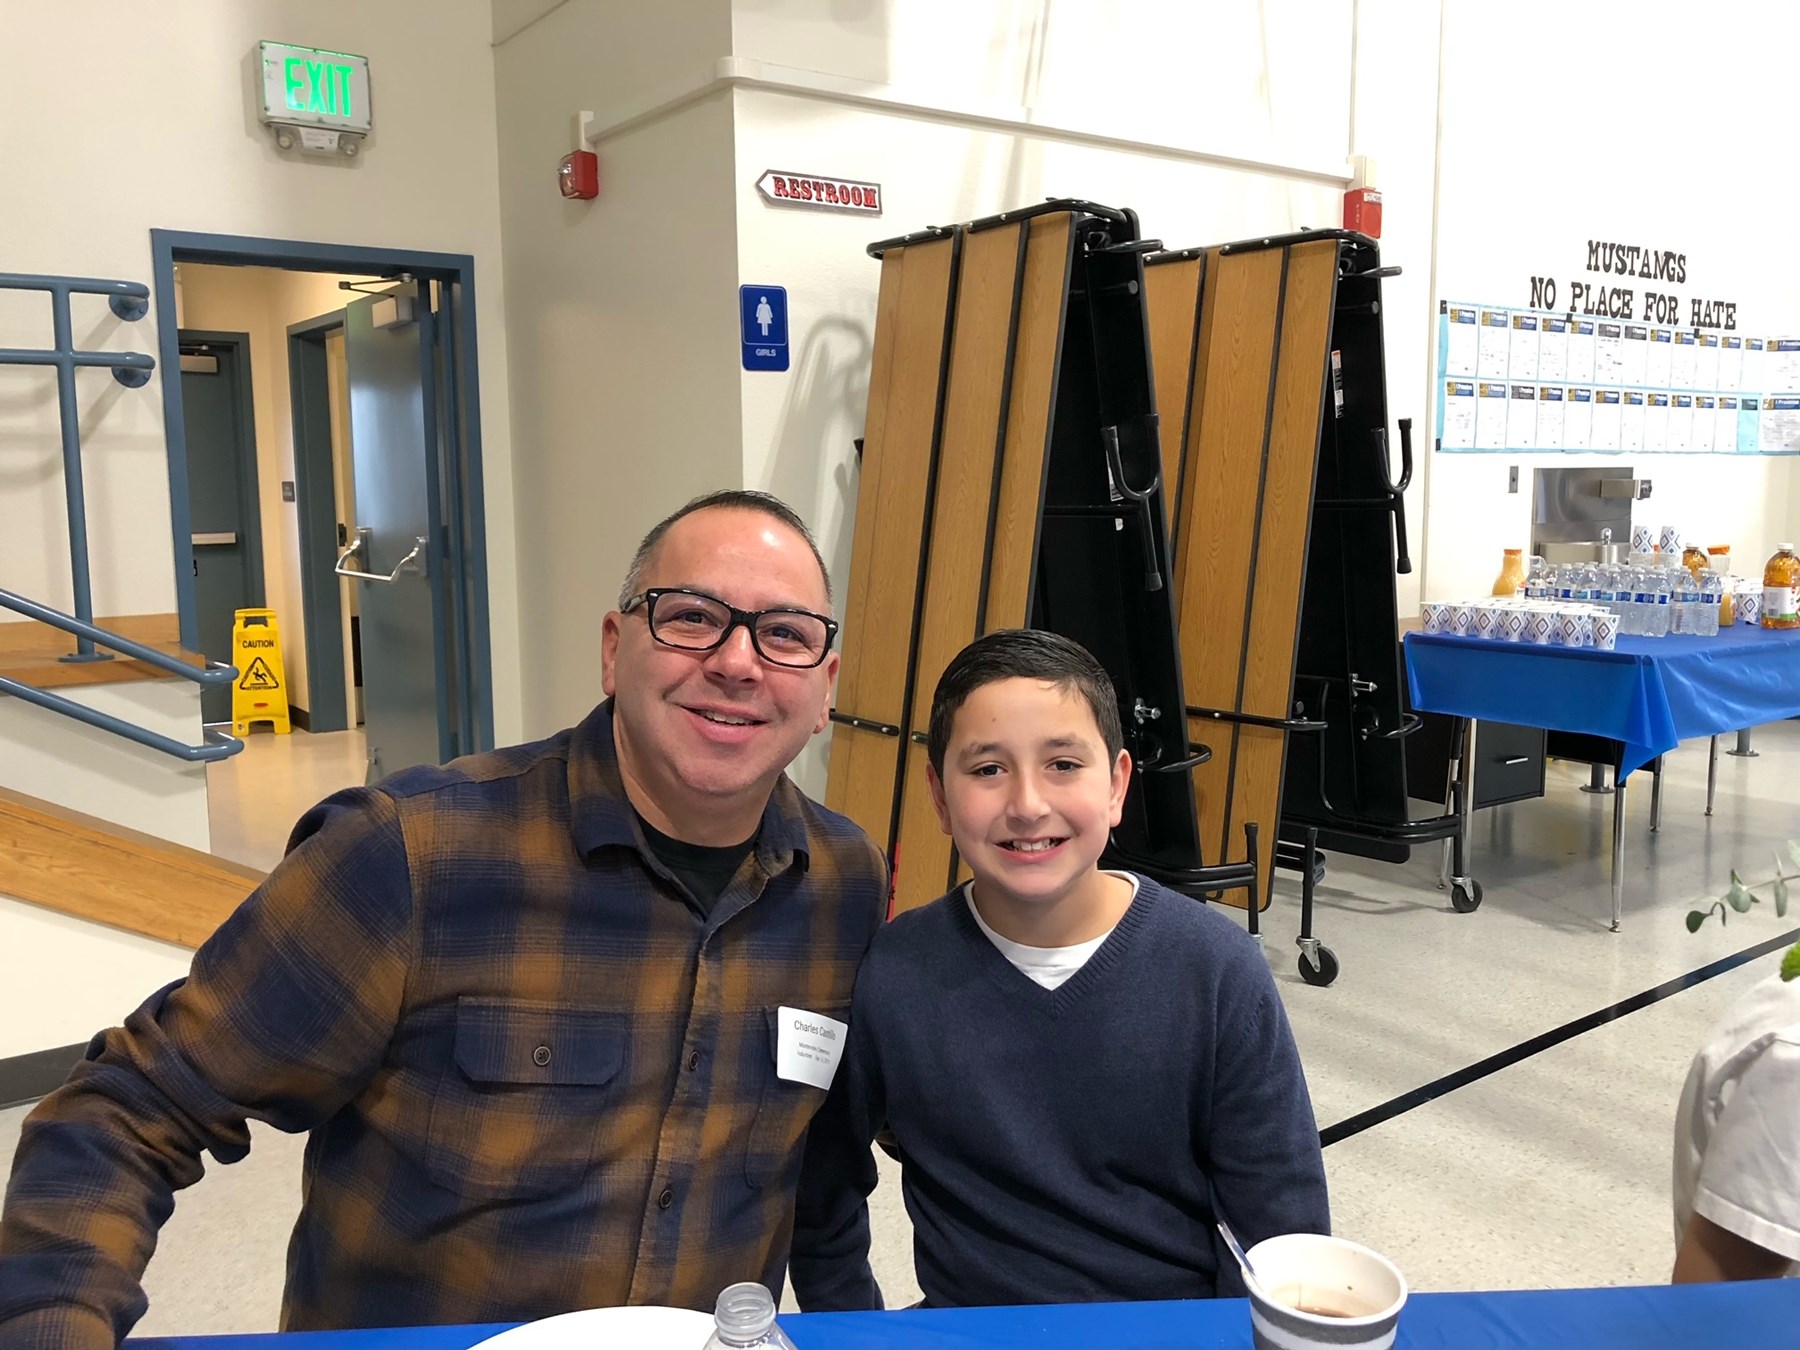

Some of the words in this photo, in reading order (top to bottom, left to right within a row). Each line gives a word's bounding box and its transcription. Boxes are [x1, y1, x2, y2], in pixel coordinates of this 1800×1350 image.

[285, 58, 353, 117] EXIT
[773, 177, 877, 208] RESTROOM
[1587, 240, 1686, 283] MUSTANGS
[1530, 276, 1556, 311] NO
[1569, 281, 1634, 320] PLACE
[1643, 292, 1680, 326] FOR
[1690, 298, 1737, 331] HATE
[755, 348, 776, 357] GIRLS
[242, 640, 274, 648] CAUTION
[794, 1020, 818, 1034] Charles
